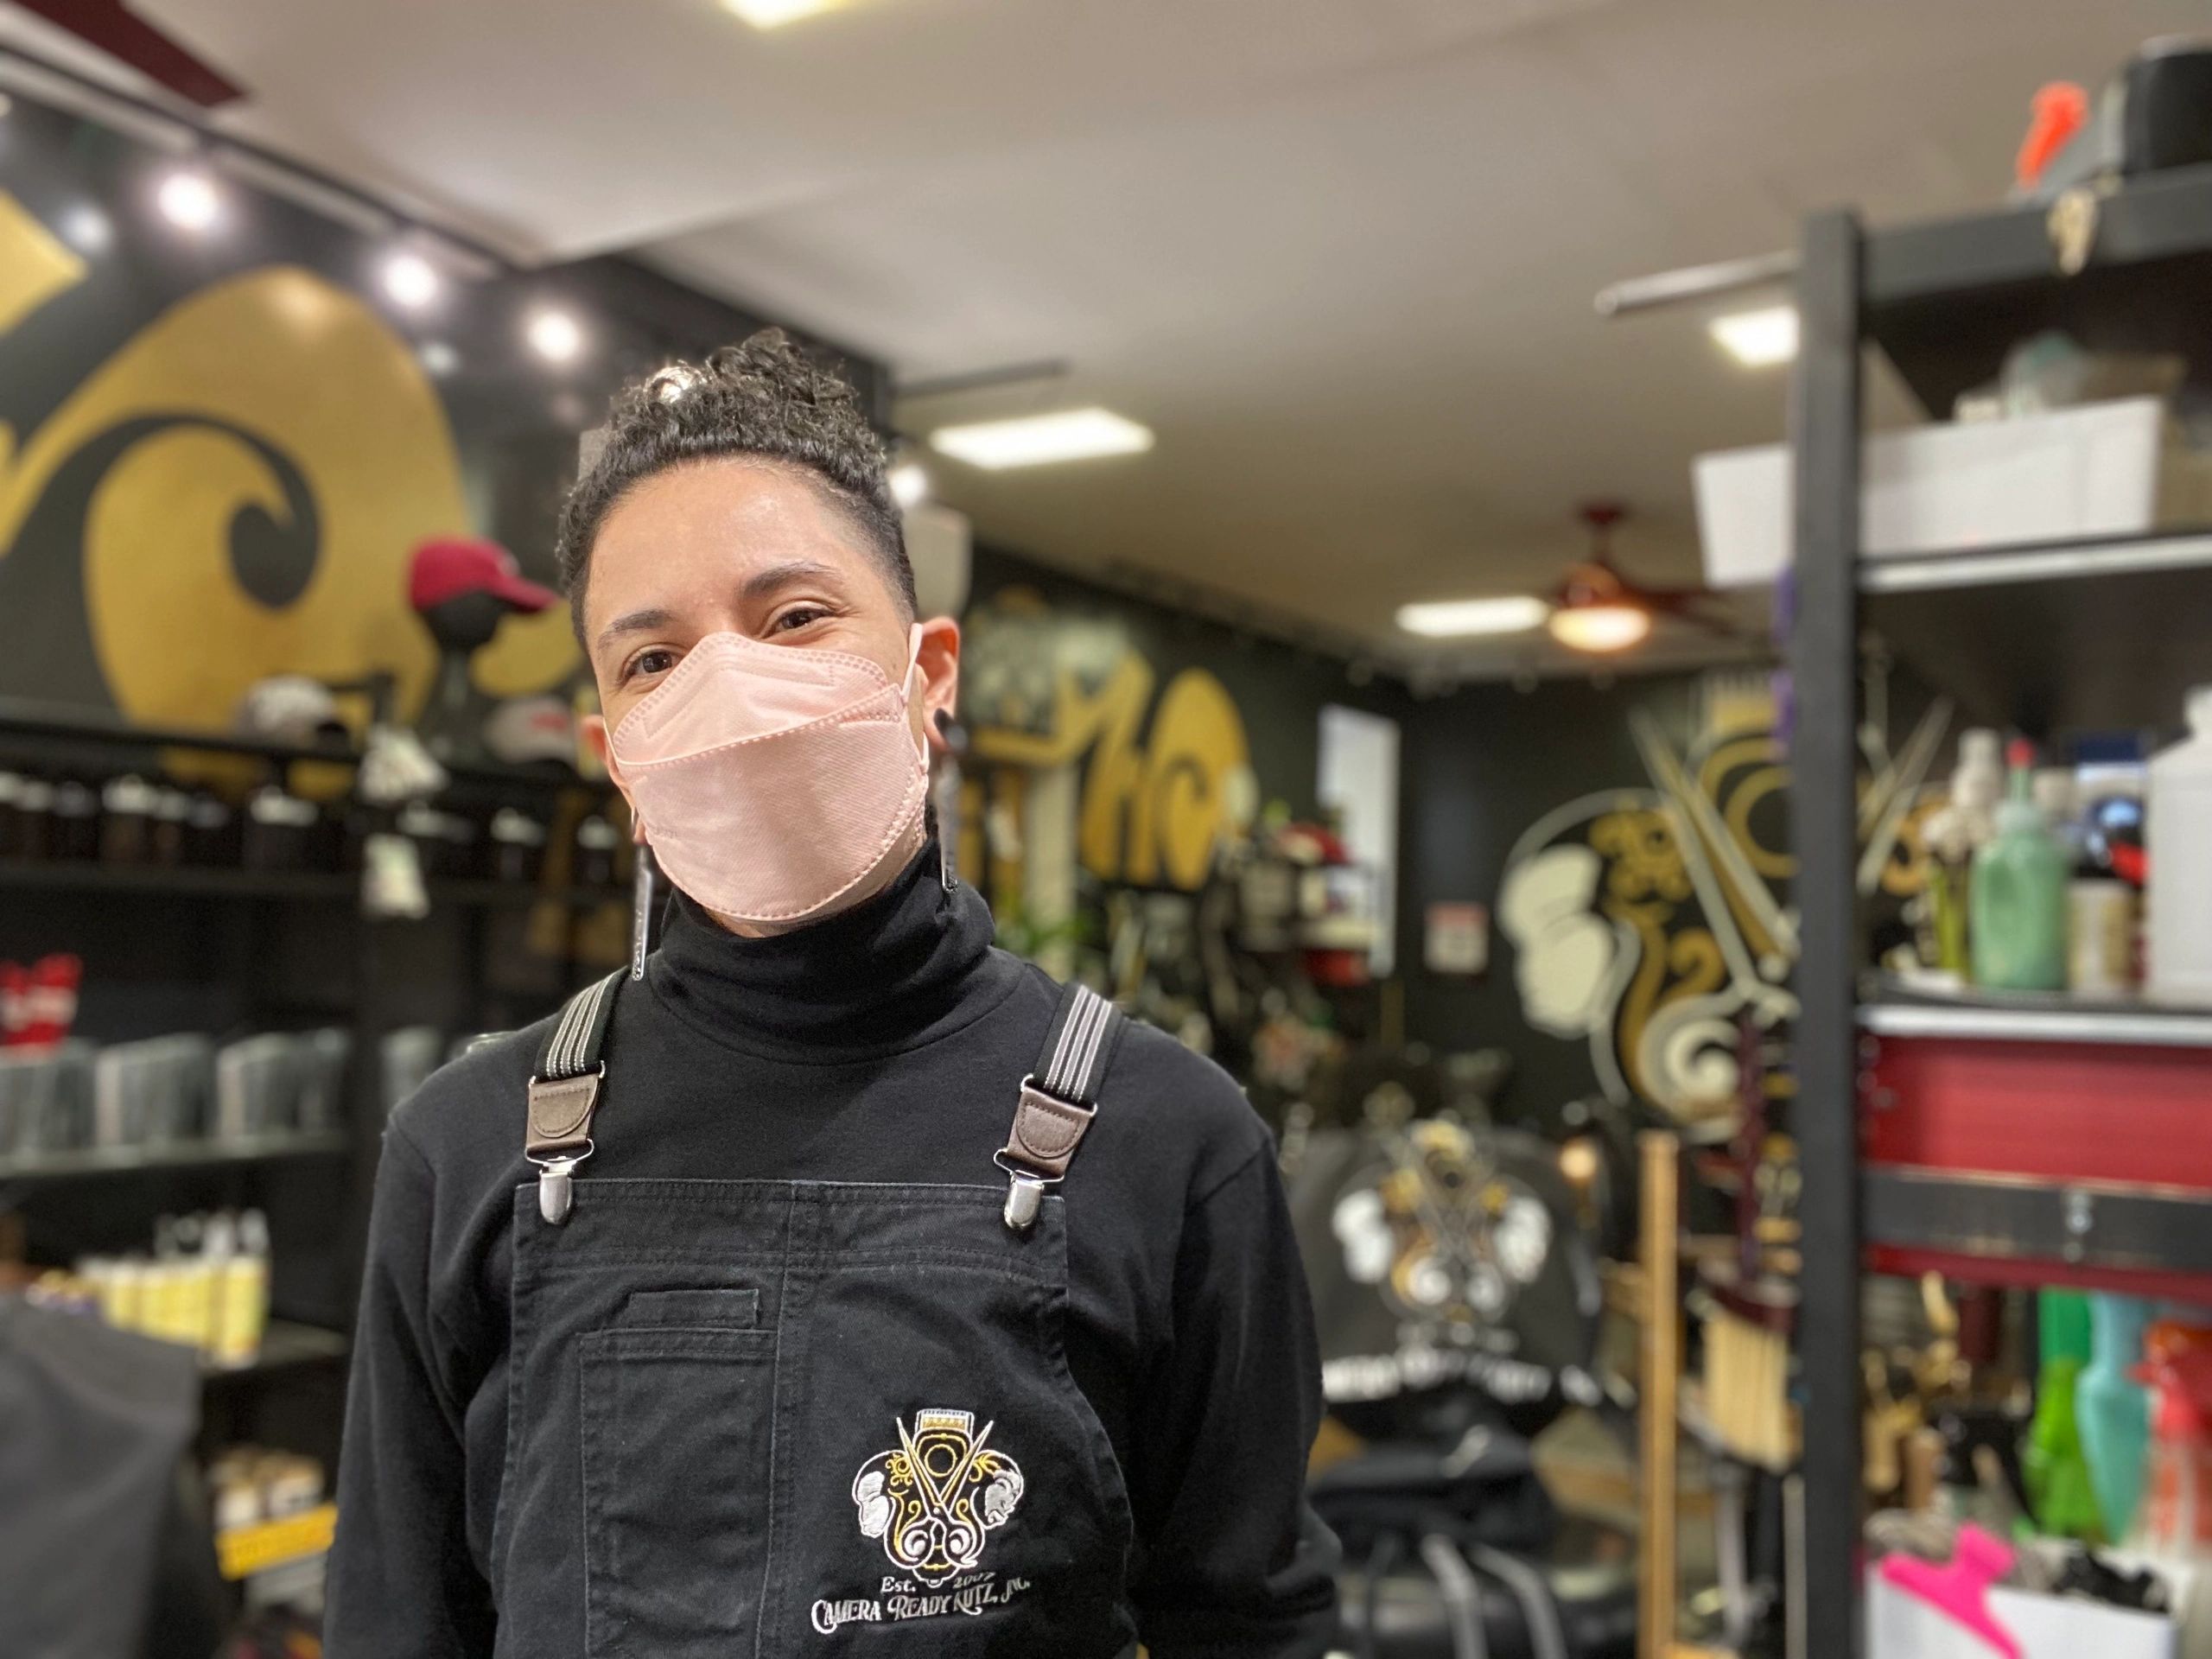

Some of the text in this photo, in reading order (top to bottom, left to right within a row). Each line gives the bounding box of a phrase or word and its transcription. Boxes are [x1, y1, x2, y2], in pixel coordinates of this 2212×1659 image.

[880, 1576, 917, 1594] Est.
[810, 1599, 882, 1635] CAMERA
[887, 1595, 952, 1621] READY
